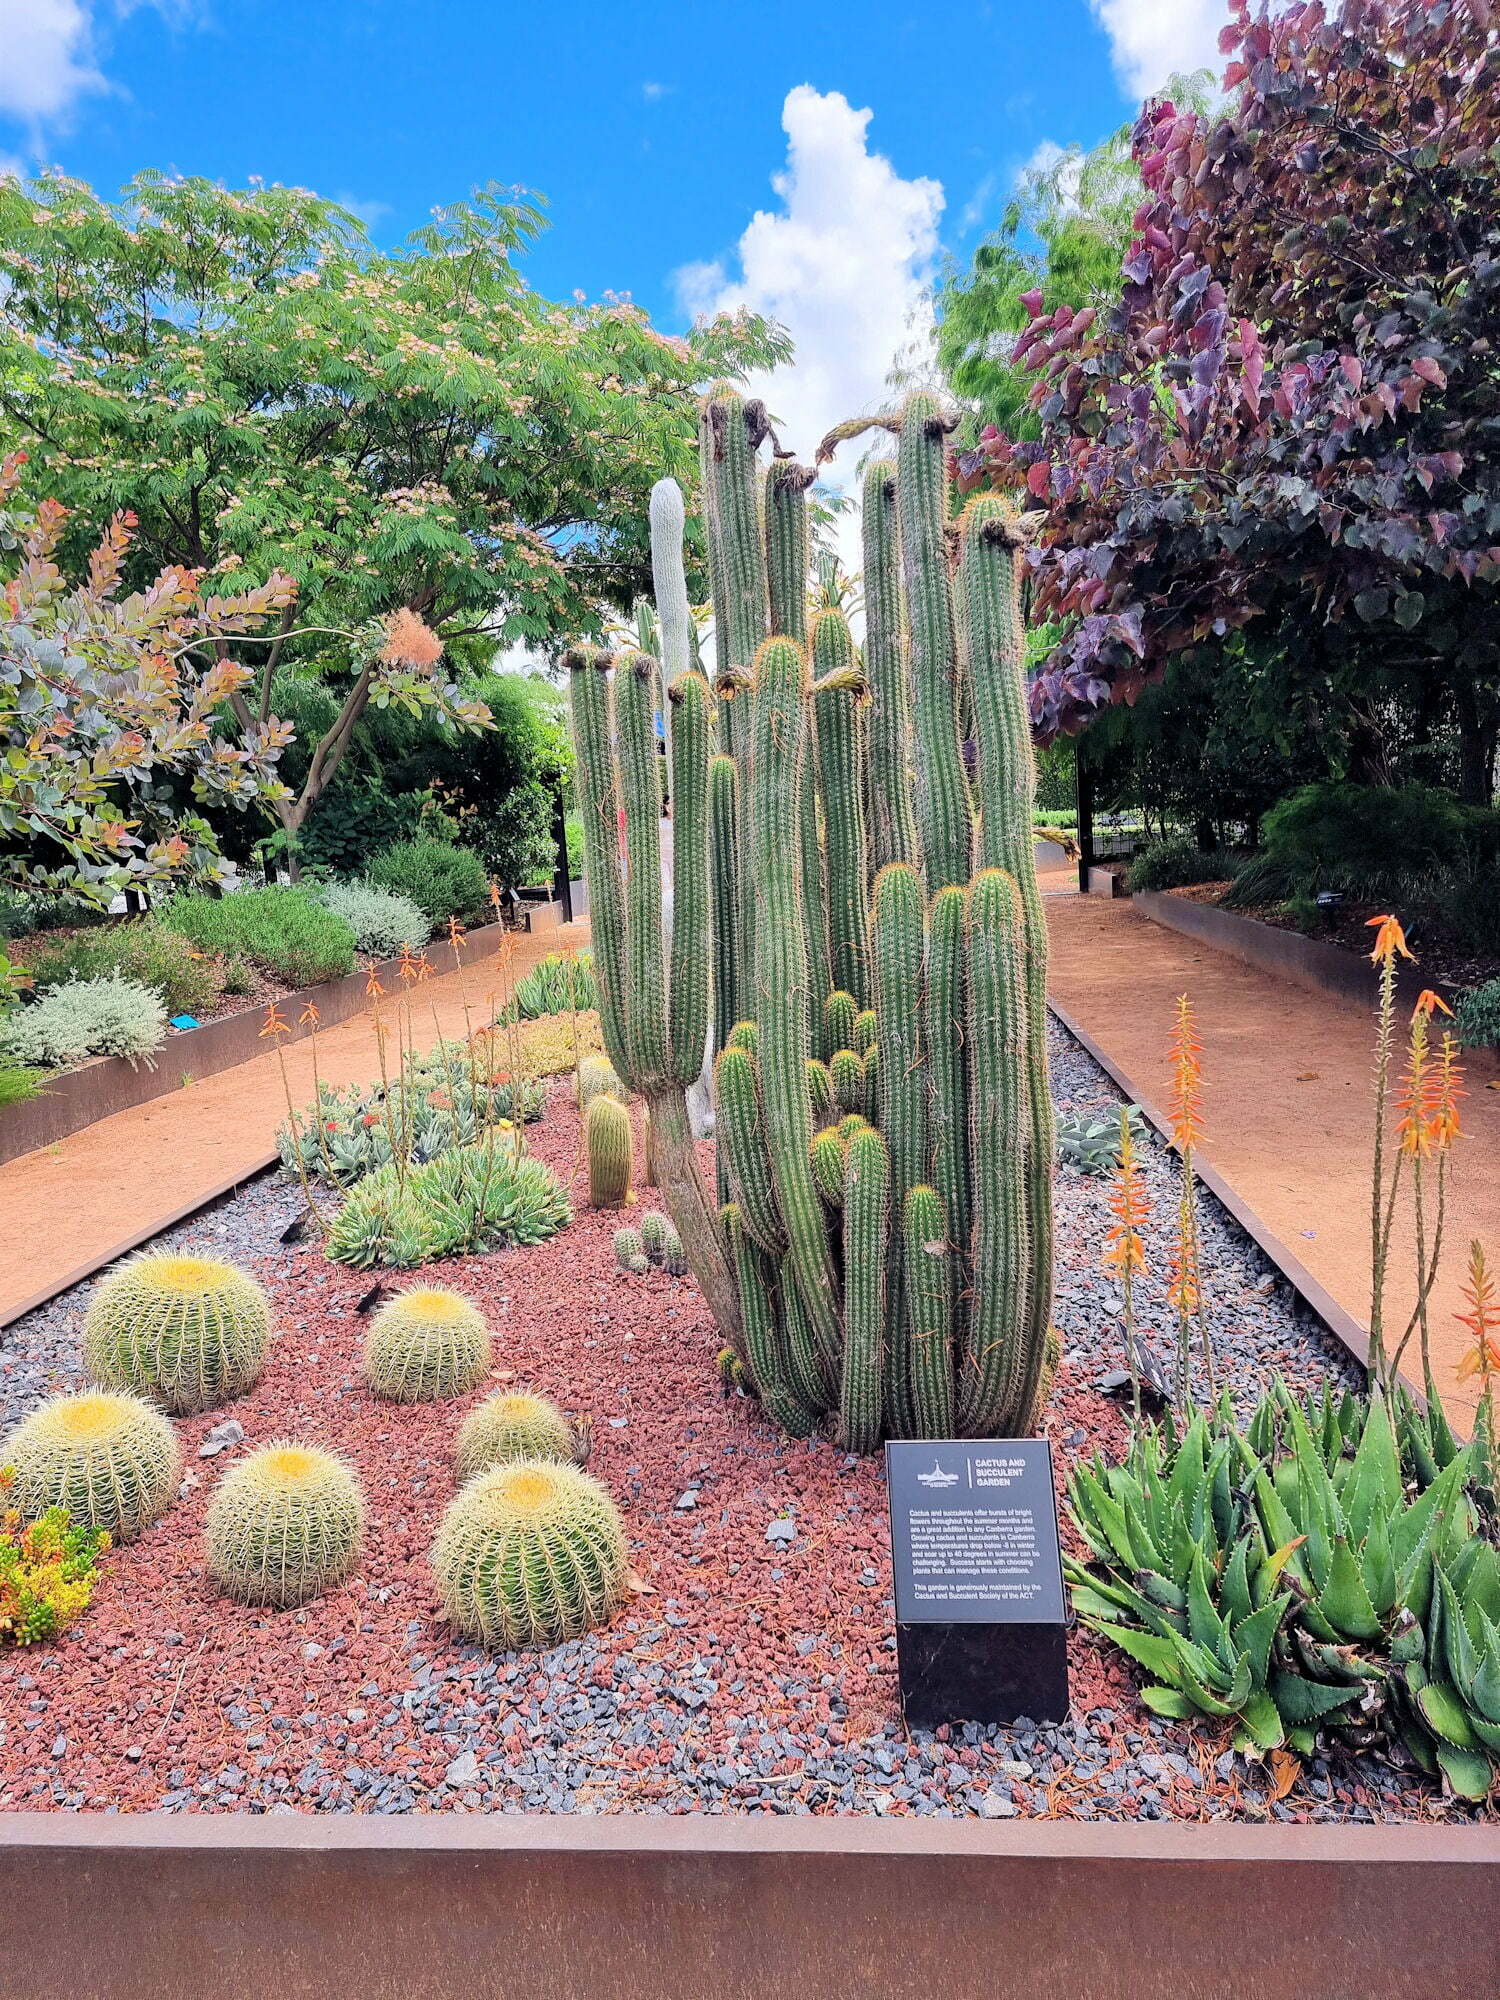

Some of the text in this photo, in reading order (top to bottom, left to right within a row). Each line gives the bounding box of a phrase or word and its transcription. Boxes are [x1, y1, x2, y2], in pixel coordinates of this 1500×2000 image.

[975, 1458, 1026, 1467] CACTUS AND
[976, 1468, 1024, 1477] SUCCULENT
[976, 1478, 1011, 1487] GARDEN
[1015, 1509, 1032, 1517] bright
[931, 1518, 962, 1526] throughout
[973, 1526, 985, 1534] any
[913, 1567, 931, 1575] plants
[927, 1583, 949, 1592] garden
[955, 1583, 988, 1592] generously
[1022, 1583, 1031, 1592] by
[914, 1591, 935, 1599] Cactus
[935, 1591, 948, 1599] and
[948, 1591, 978, 1599] Succulent
[978, 1591, 1000, 1600] Society
[1001, 1591, 1008, 1599] of
[1008, 1591, 1019, 1599] the
